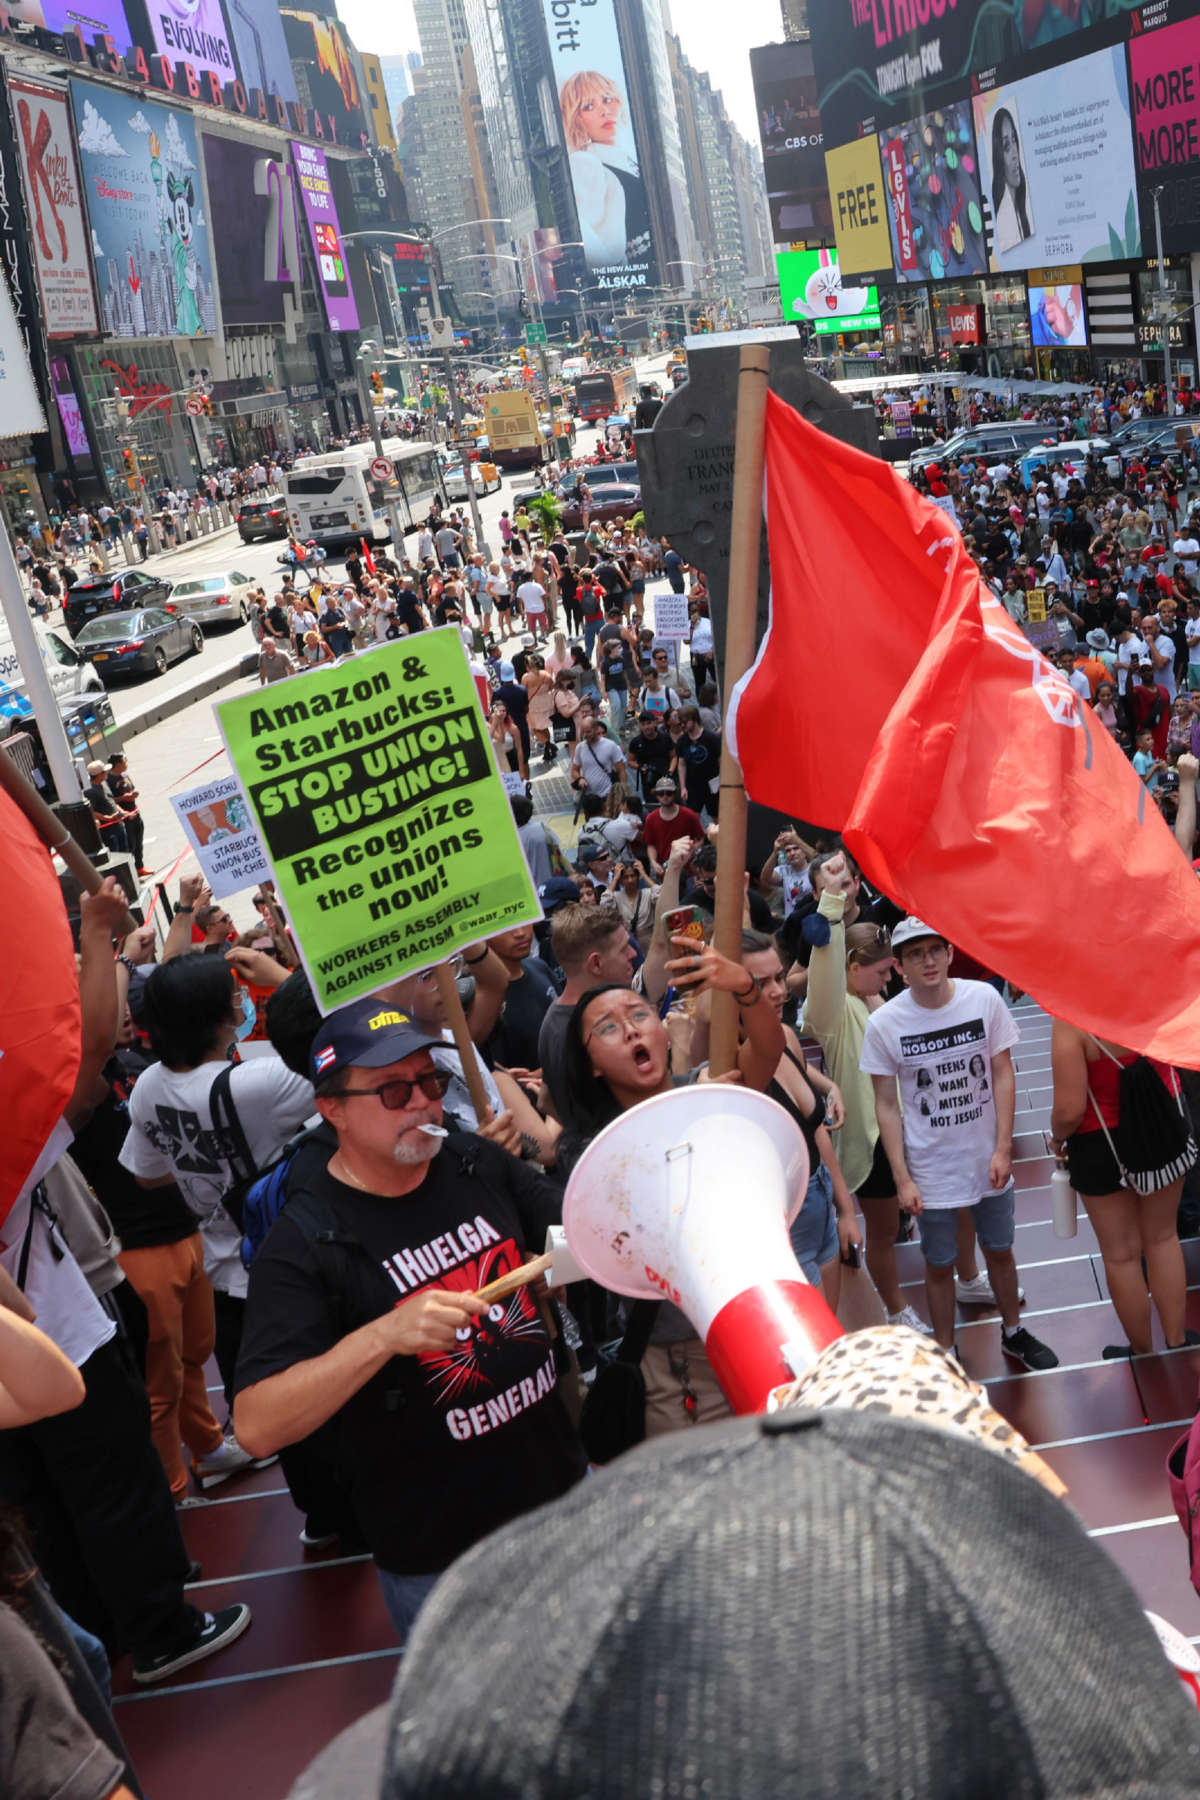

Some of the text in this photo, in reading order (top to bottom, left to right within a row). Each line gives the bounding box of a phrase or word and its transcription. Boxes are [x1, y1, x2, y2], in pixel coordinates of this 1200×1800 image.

[160, 14, 232, 69] EVOLVING
[920, 38, 943, 78] FOX
[73, 24, 337, 143] 1540 BROADWAY
[1134, 65, 1195, 115] MORE
[785, 137, 808, 149] CBS
[1139, 118, 1200, 171] MORE
[373, 157, 387, 198] 1500
[837, 183, 879, 231] FREE
[1139, 326, 1182, 342] SEPHRA
[250, 656, 430, 738] Amazon &
[255, 686, 455, 772] Starbucks:
[259, 715, 475, 816] STOP UNION
[178, 781, 238, 810] HOWARD SCHU
[312, 755, 470, 835] BUSTING!
[211, 847, 262, 874] UNION-BUS
[290, 797, 475, 886] Recognize
[317, 827, 483, 912] the unions
[369, 864, 450, 922] now!
[317, 891, 481, 976] WORKERS ASSEMBLY
[325, 955, 393, 996] AGAINST
[397, 926, 455, 962] RACISM
[902, 1036, 949, 1056] NOBODY
[953, 1030, 977, 1045] INC.
[936, 1058, 966, 1076] TEENS
[938, 1076, 969, 1093] WANT
[939, 1092, 973, 1111] MITSKI
[930, 1106, 983, 1129] NOT JESUS!
[446, 1349, 557, 1441] GENERAL!
